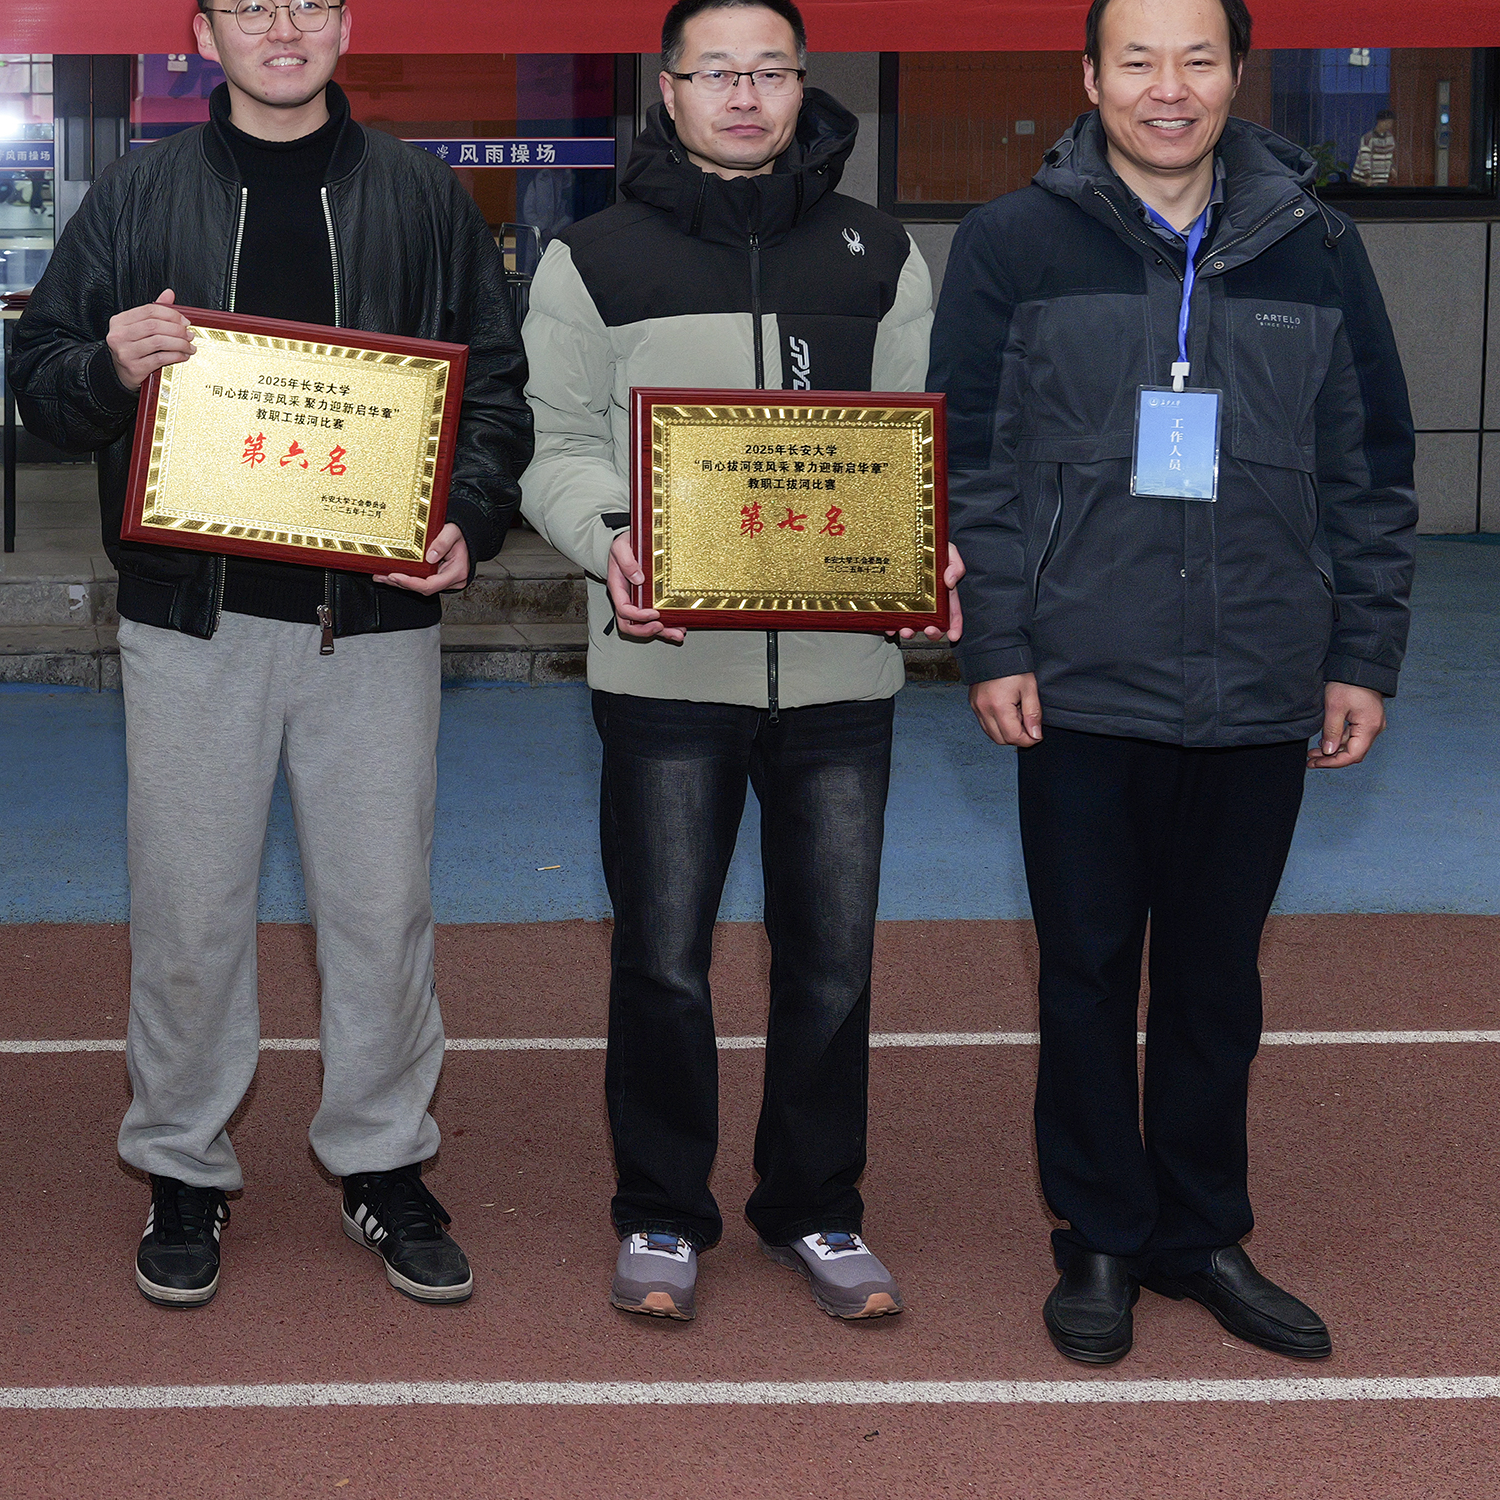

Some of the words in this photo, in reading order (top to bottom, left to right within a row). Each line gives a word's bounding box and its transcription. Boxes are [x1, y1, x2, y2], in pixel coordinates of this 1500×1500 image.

[459, 144, 556, 163] 风雨操场
[1255, 313, 1300, 324] CARTELO
[256, 375, 351, 396] 2025年长安大学
[256, 408, 344, 430] 教职工拔河比赛
[241, 432, 347, 476] 第六名
[745, 444, 837, 457] 2025年长安大学
[1169, 418, 1184, 471] 工作人员
[748, 478, 836, 490] 教职工拔河比赛
[740, 501, 845, 539] 第七名
